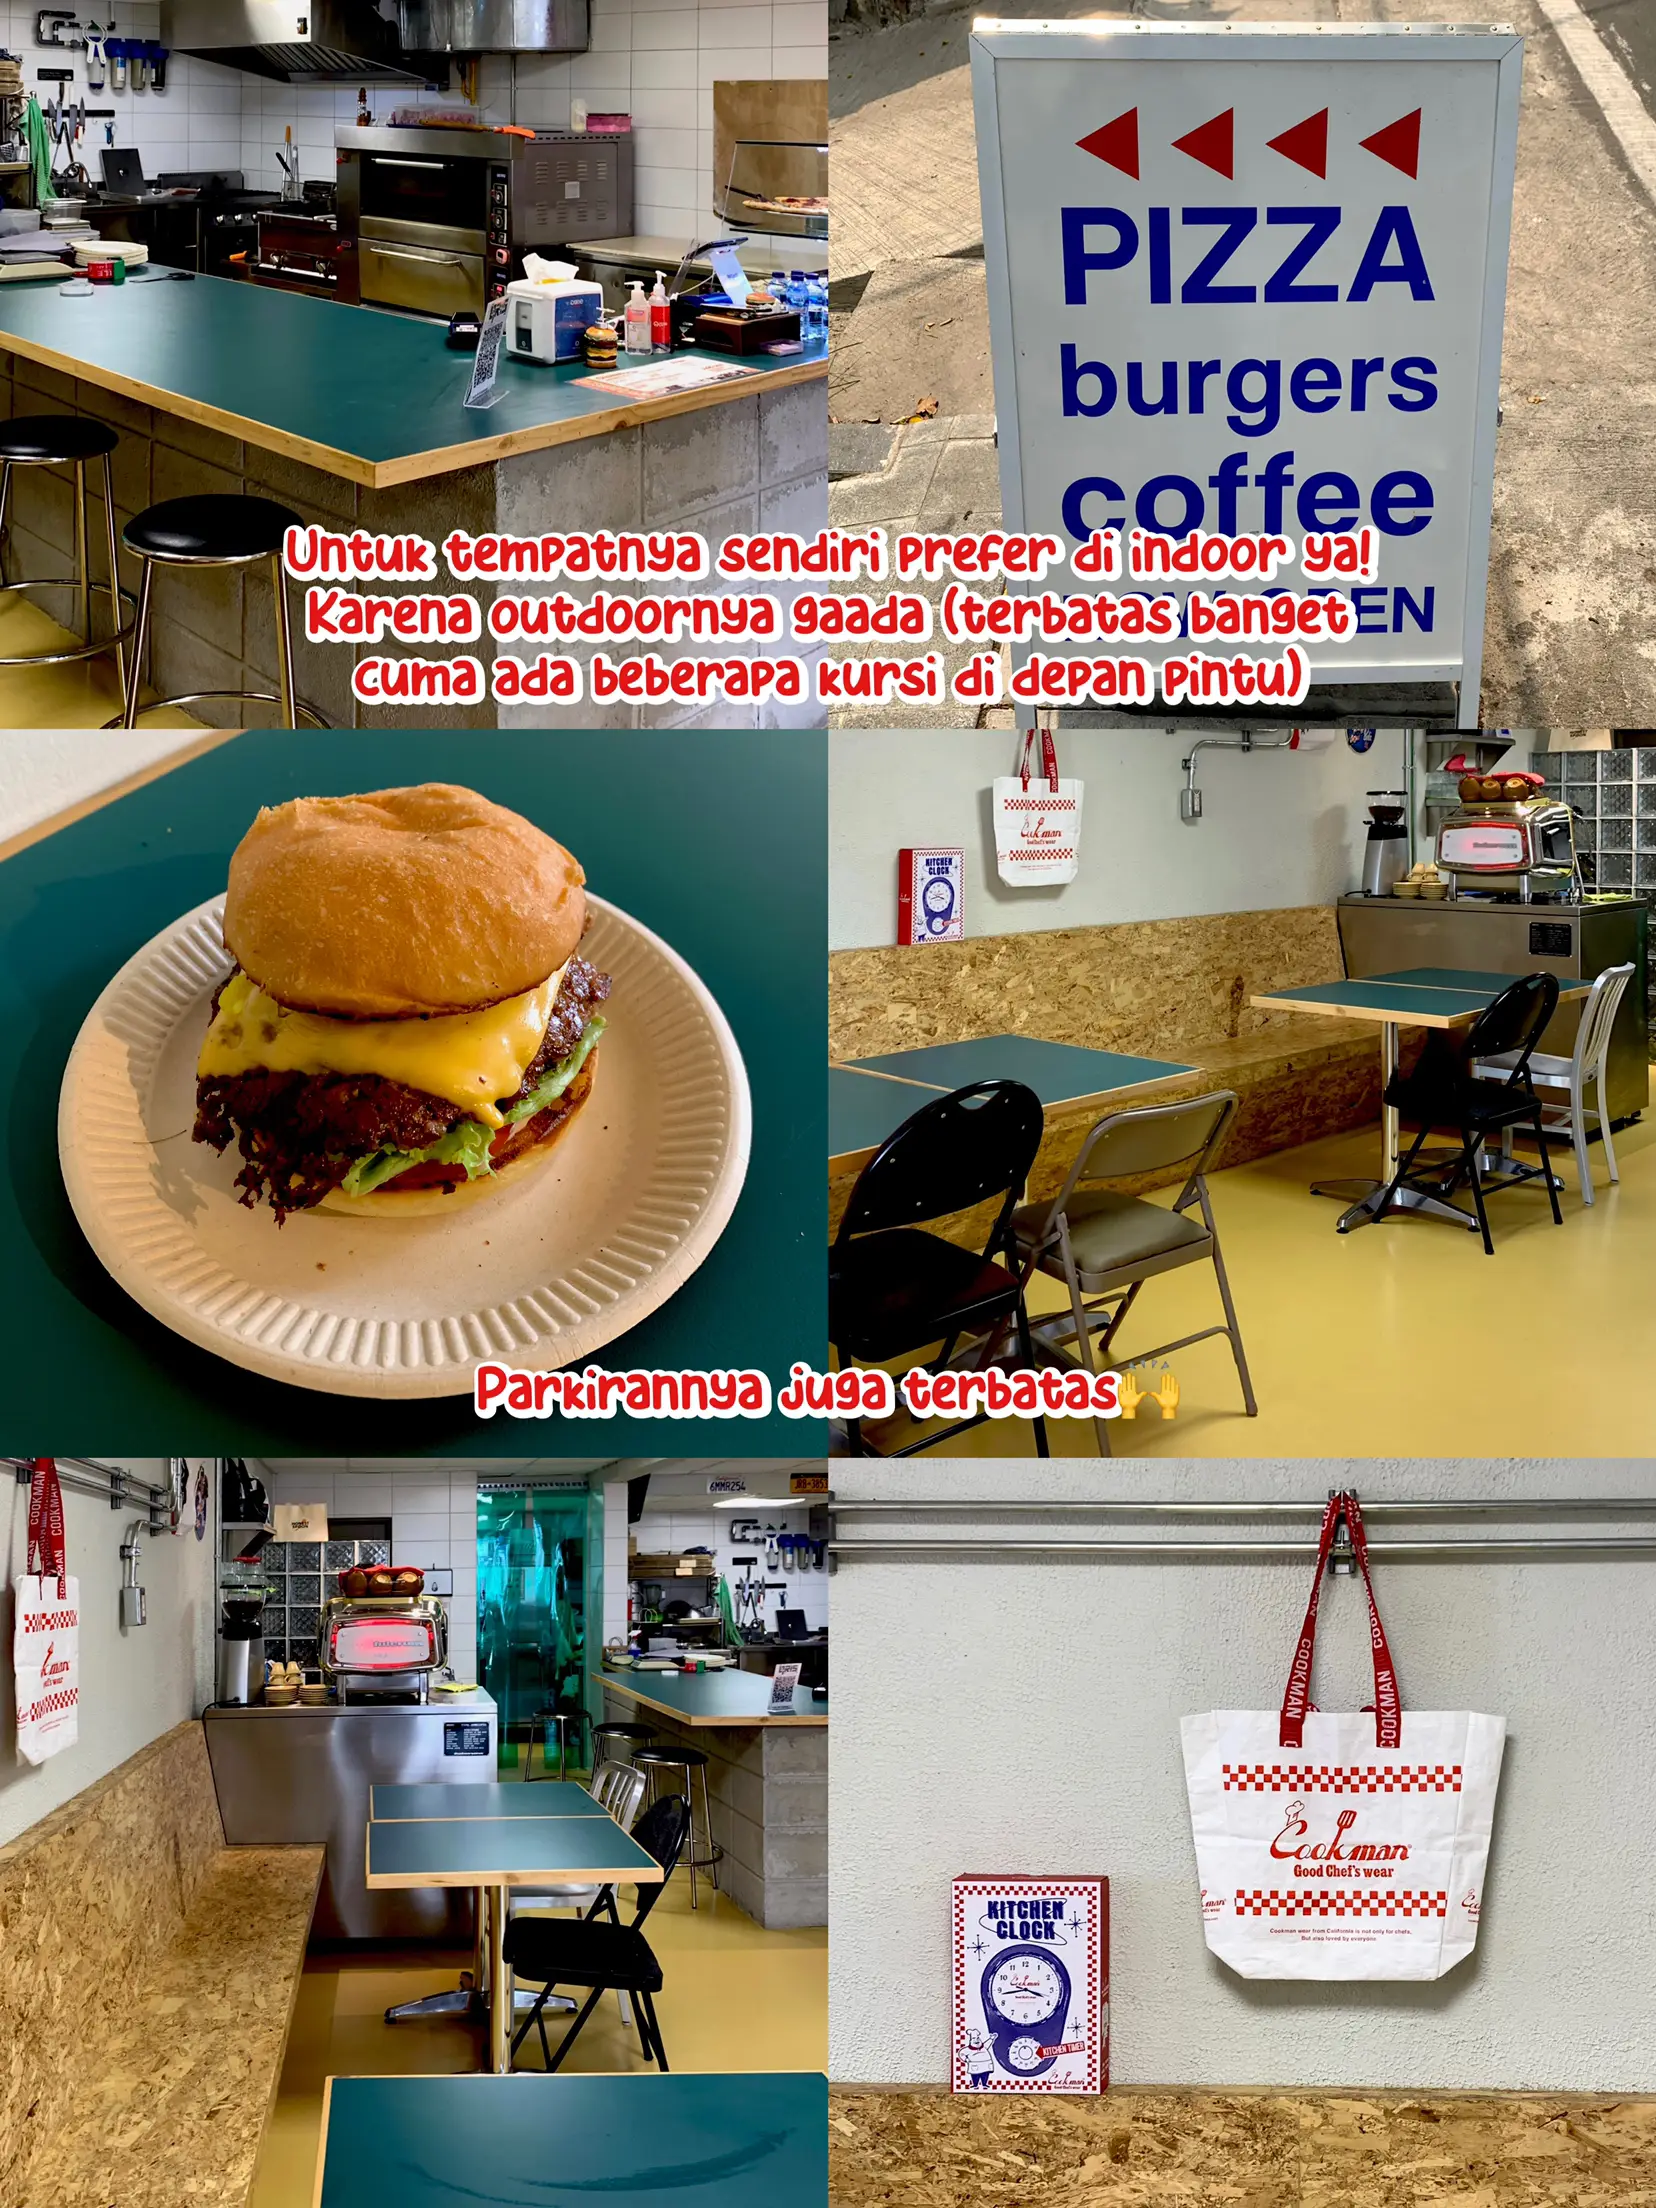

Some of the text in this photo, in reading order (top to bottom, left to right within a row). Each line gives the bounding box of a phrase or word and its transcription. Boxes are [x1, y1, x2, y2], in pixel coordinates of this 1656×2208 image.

[1061, 206, 1436, 304] PIZZA
[1060, 344, 1438, 438] burgers
[1061, 451, 1434, 542] coffee
[30, 1471, 46, 1526] COOKMAN
[50, 1483, 63, 1537] COOKMAN
[1285, 1638, 1312, 1719] COOKMAN
[1378, 1670, 1400, 1748] COOKMAN
[1269, 1810, 1411, 1861] Cookman
[1293, 1864, 1395, 1878] Good Chef's wear
[987, 1899, 1065, 1921] KITCHEN
[995, 1920, 1056, 1941] CLOCK
[1043, 2043, 1067, 2057] KITCHEN
[1066, 2041, 1085, 2053] TIMER
